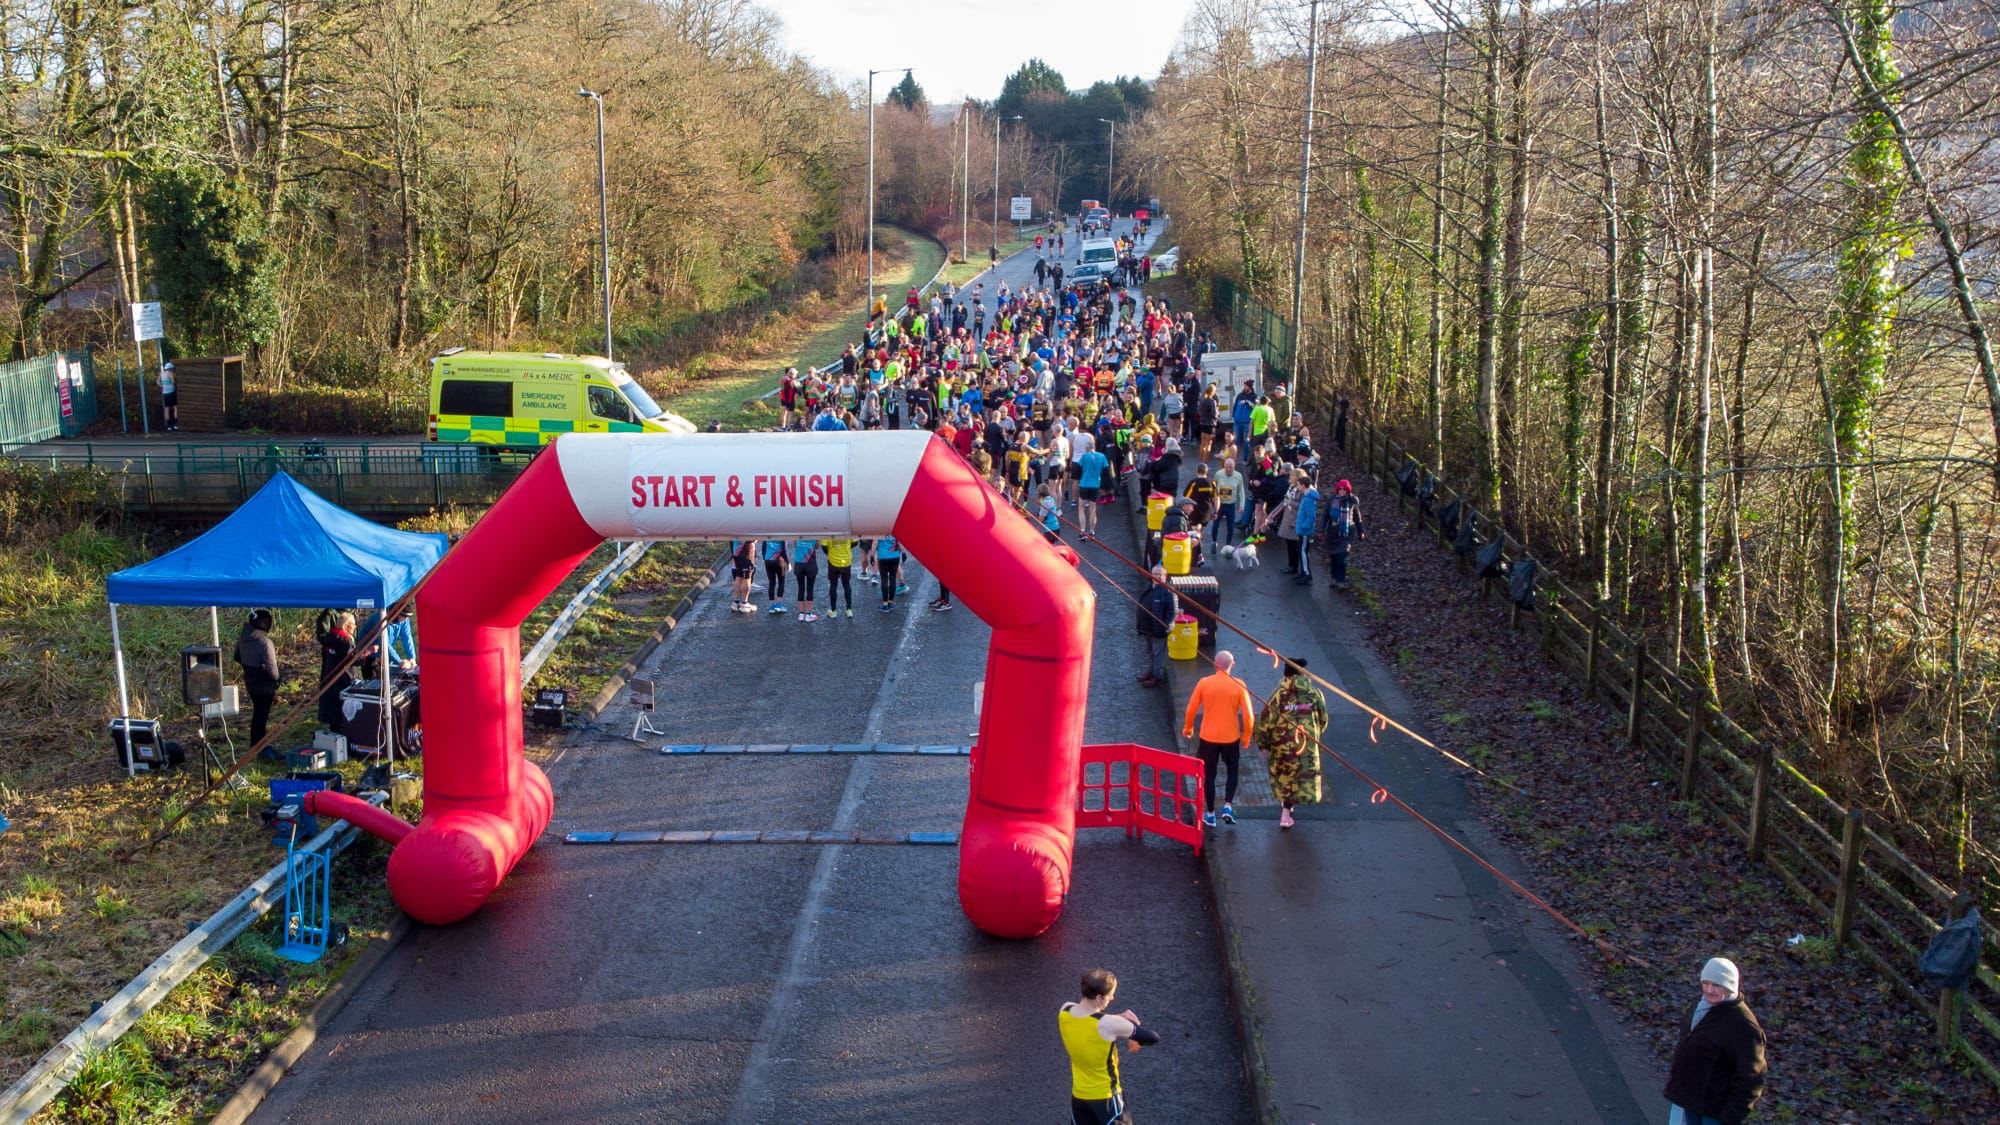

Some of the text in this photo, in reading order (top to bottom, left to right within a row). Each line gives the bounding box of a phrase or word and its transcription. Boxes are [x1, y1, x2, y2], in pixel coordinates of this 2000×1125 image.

[548, 373, 574, 381] MEDIC
[521, 391, 566, 401] EMERGENCY
[522, 400, 568, 410] AMBULANCE
[631, 475, 844, 508] START & FINISH
